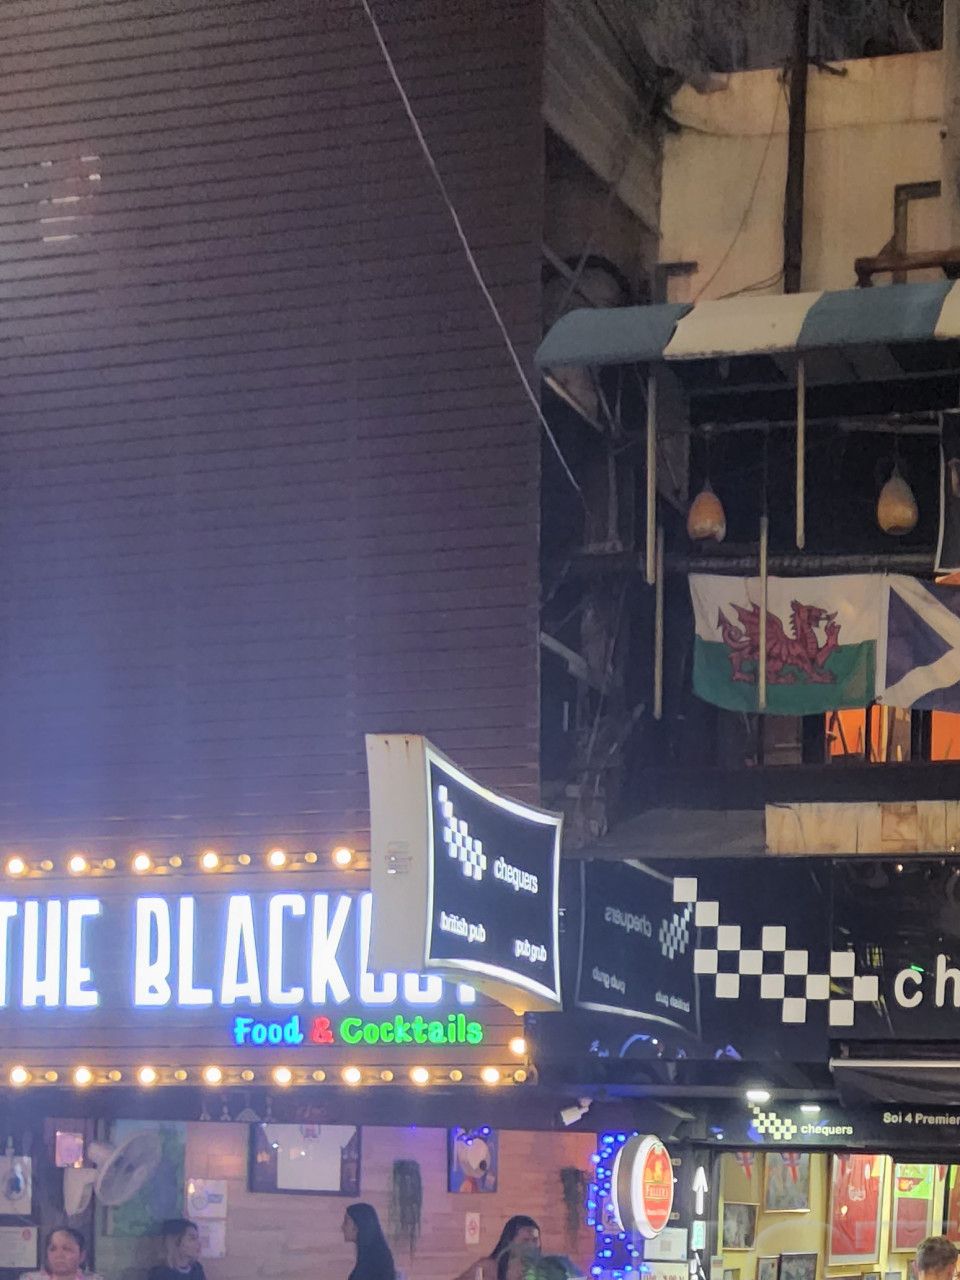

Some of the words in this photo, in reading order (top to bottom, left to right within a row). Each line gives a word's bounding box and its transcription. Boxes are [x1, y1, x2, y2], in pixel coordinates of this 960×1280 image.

[494, 856, 539, 893] chequers
[440, 911, 468, 937] british
[467, 924, 486, 943] pub
[135, 893, 475, 1006] BLACK
[515, 939, 531, 957] pub
[234, 1015, 303, 1044] Food
[312, 1016, 335, 1044] &
[340, 1013, 483, 1044] Cocktails
[801, 1123, 853, 1136] chequers
[883, 1112, 902, 1123] Soi
[905, 1113, 913, 1123] 4
